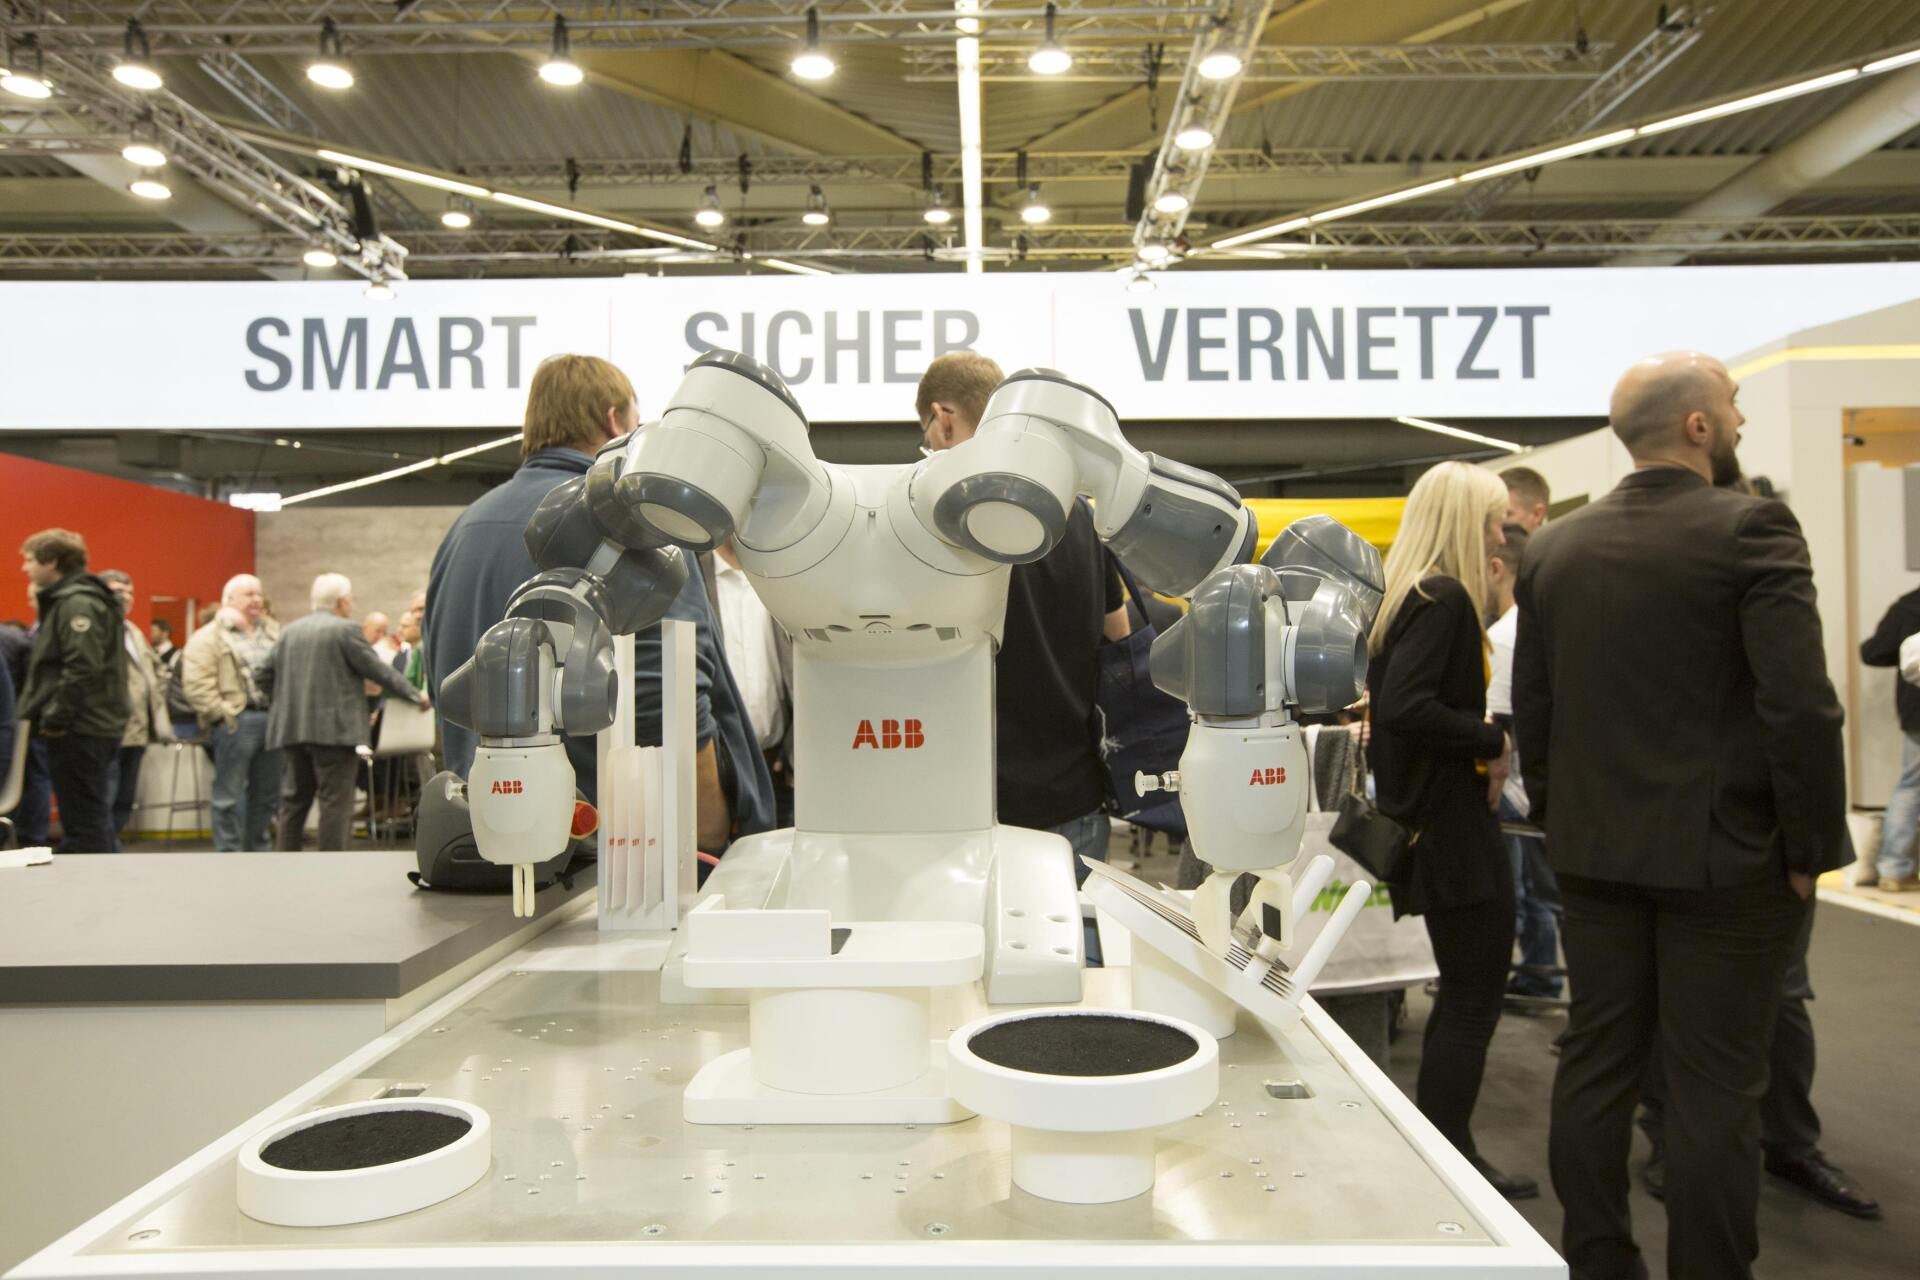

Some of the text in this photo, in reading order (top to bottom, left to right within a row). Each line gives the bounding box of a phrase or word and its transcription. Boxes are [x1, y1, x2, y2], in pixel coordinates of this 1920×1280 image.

[244, 306, 1551, 392] SMART SICHER VERNETZT
[852, 718, 925, 749] ABB
[491, 780, 523, 794] ABB
[1249, 766, 1286, 785] ABB
